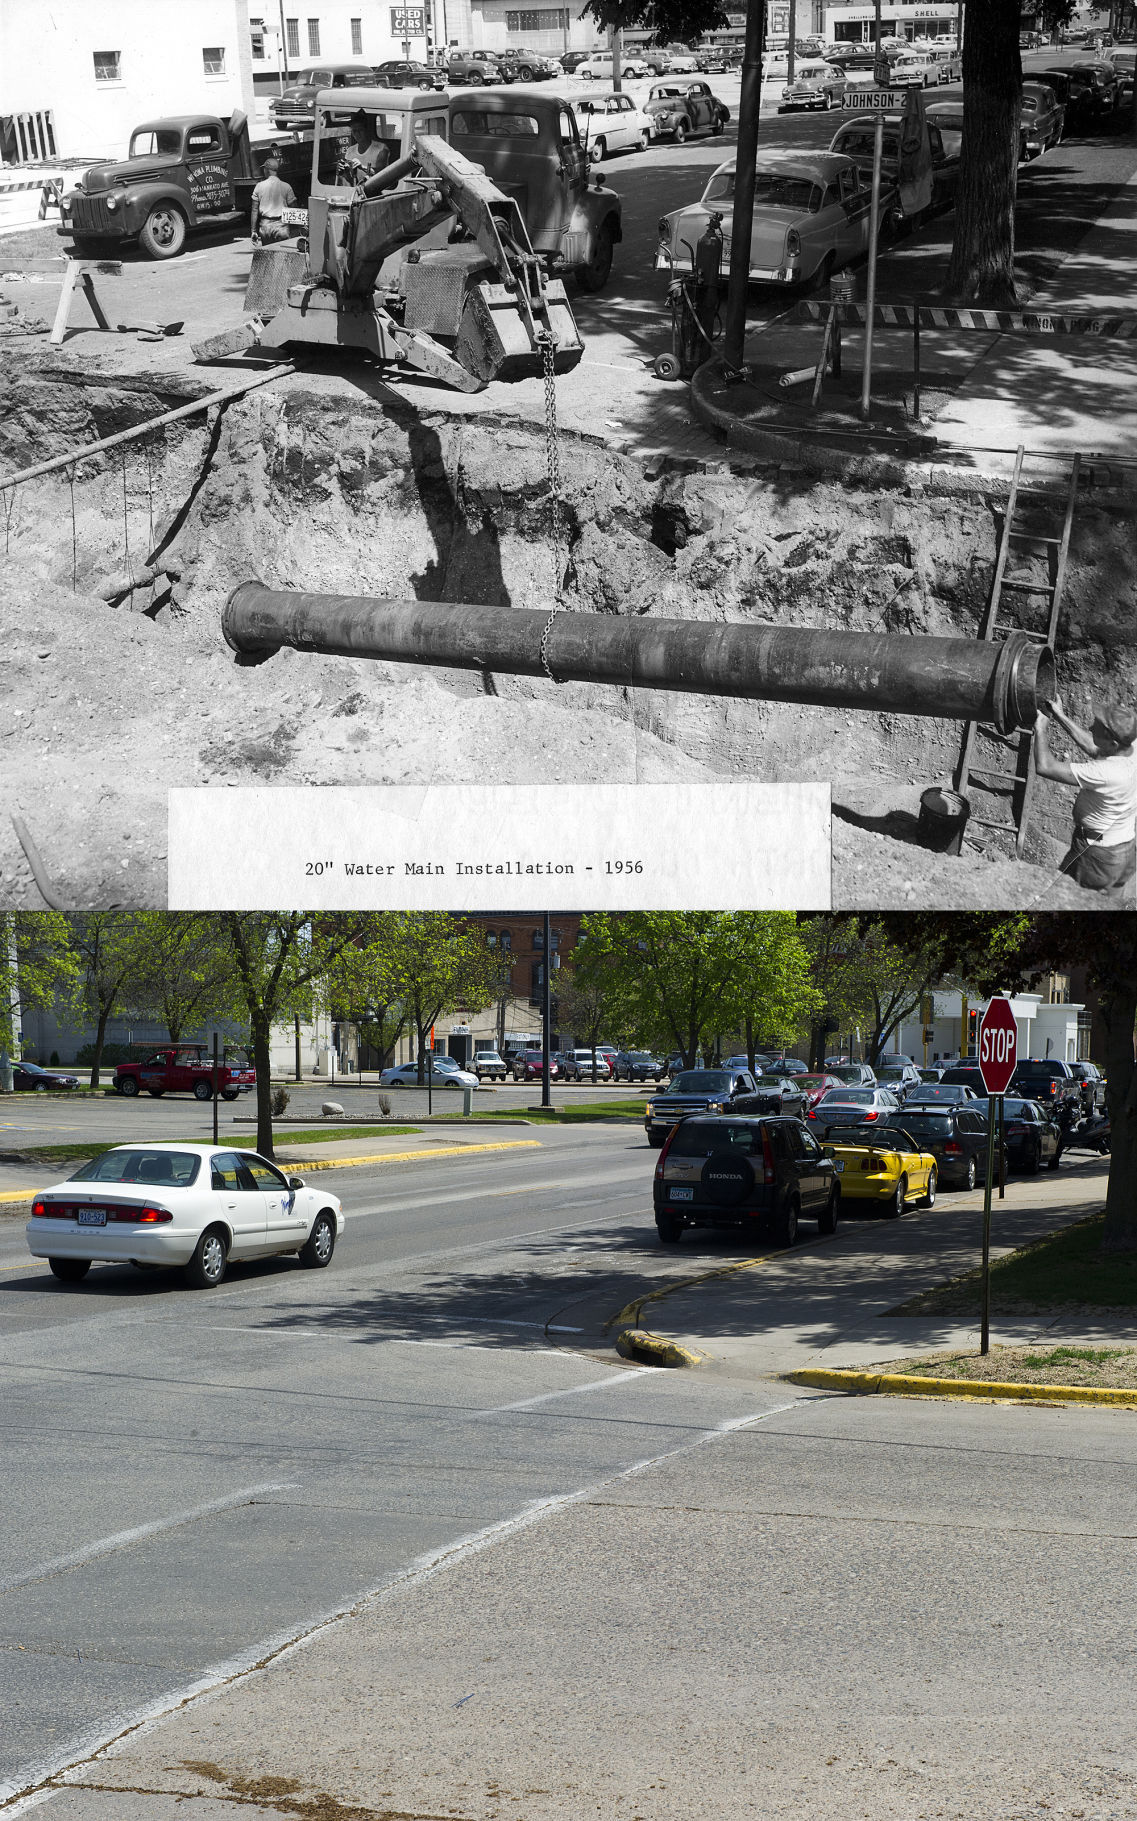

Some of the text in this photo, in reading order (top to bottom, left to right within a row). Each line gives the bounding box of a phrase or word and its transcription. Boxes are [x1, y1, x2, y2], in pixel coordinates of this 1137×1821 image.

[395, 10, 420, 19] USED
[395, 19, 420, 29] CARS
[205, 165, 228, 177] PLUMBING
[982, 1028, 1015, 1063] STOP
[708, 1172, 744, 1180] HONDA
